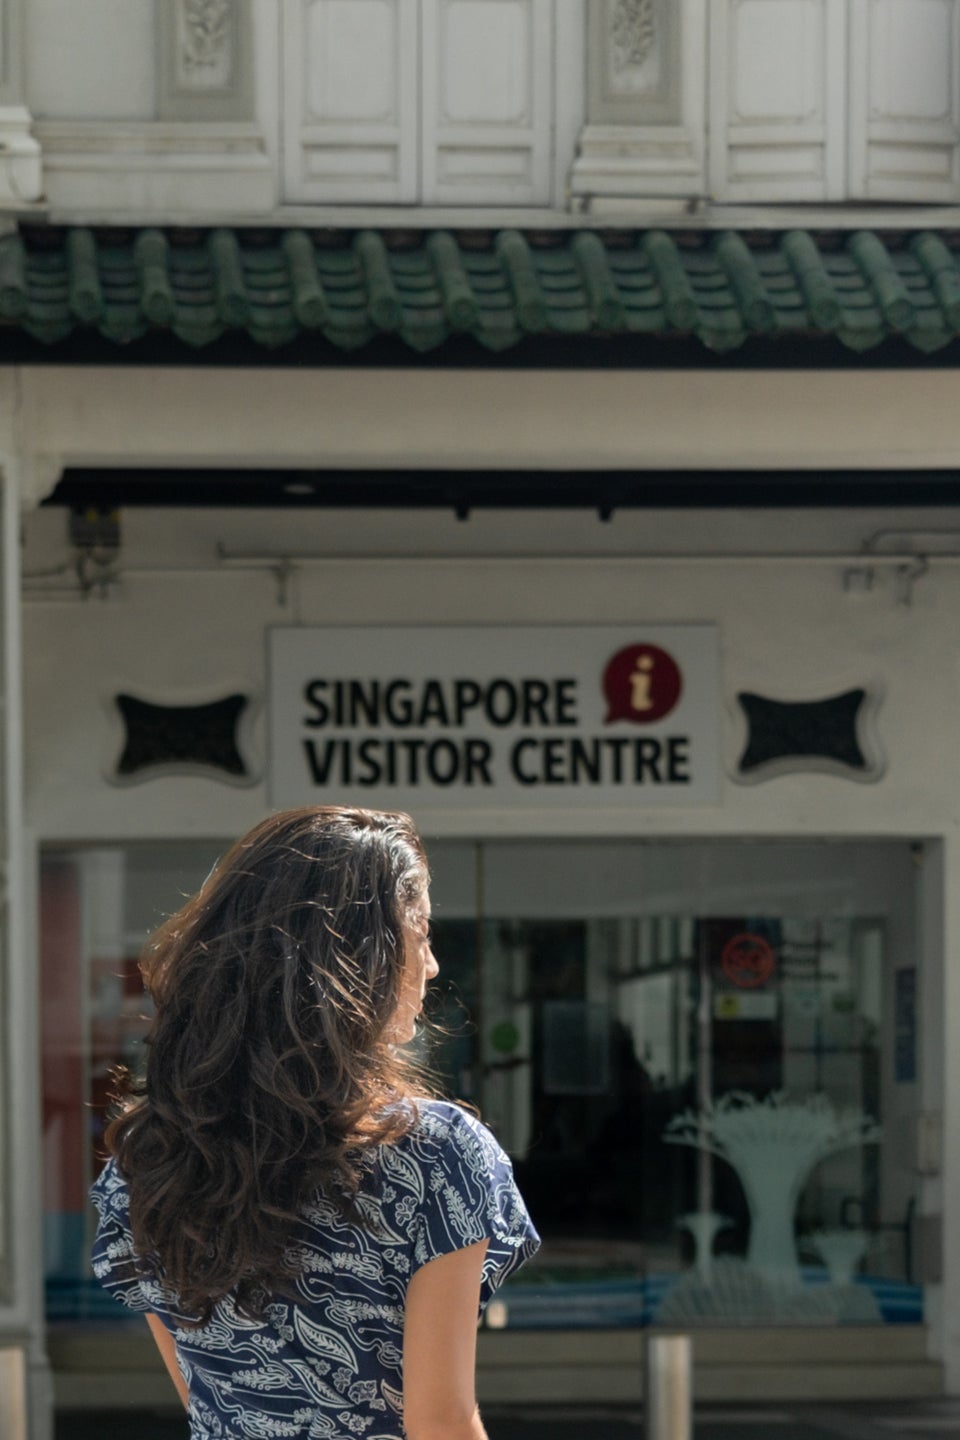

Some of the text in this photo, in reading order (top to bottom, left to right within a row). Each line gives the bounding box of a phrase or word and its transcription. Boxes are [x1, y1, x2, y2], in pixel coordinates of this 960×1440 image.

[304, 677, 578, 727] SINGAPORE
[304, 735, 692, 786] VISITOR CENTRE
